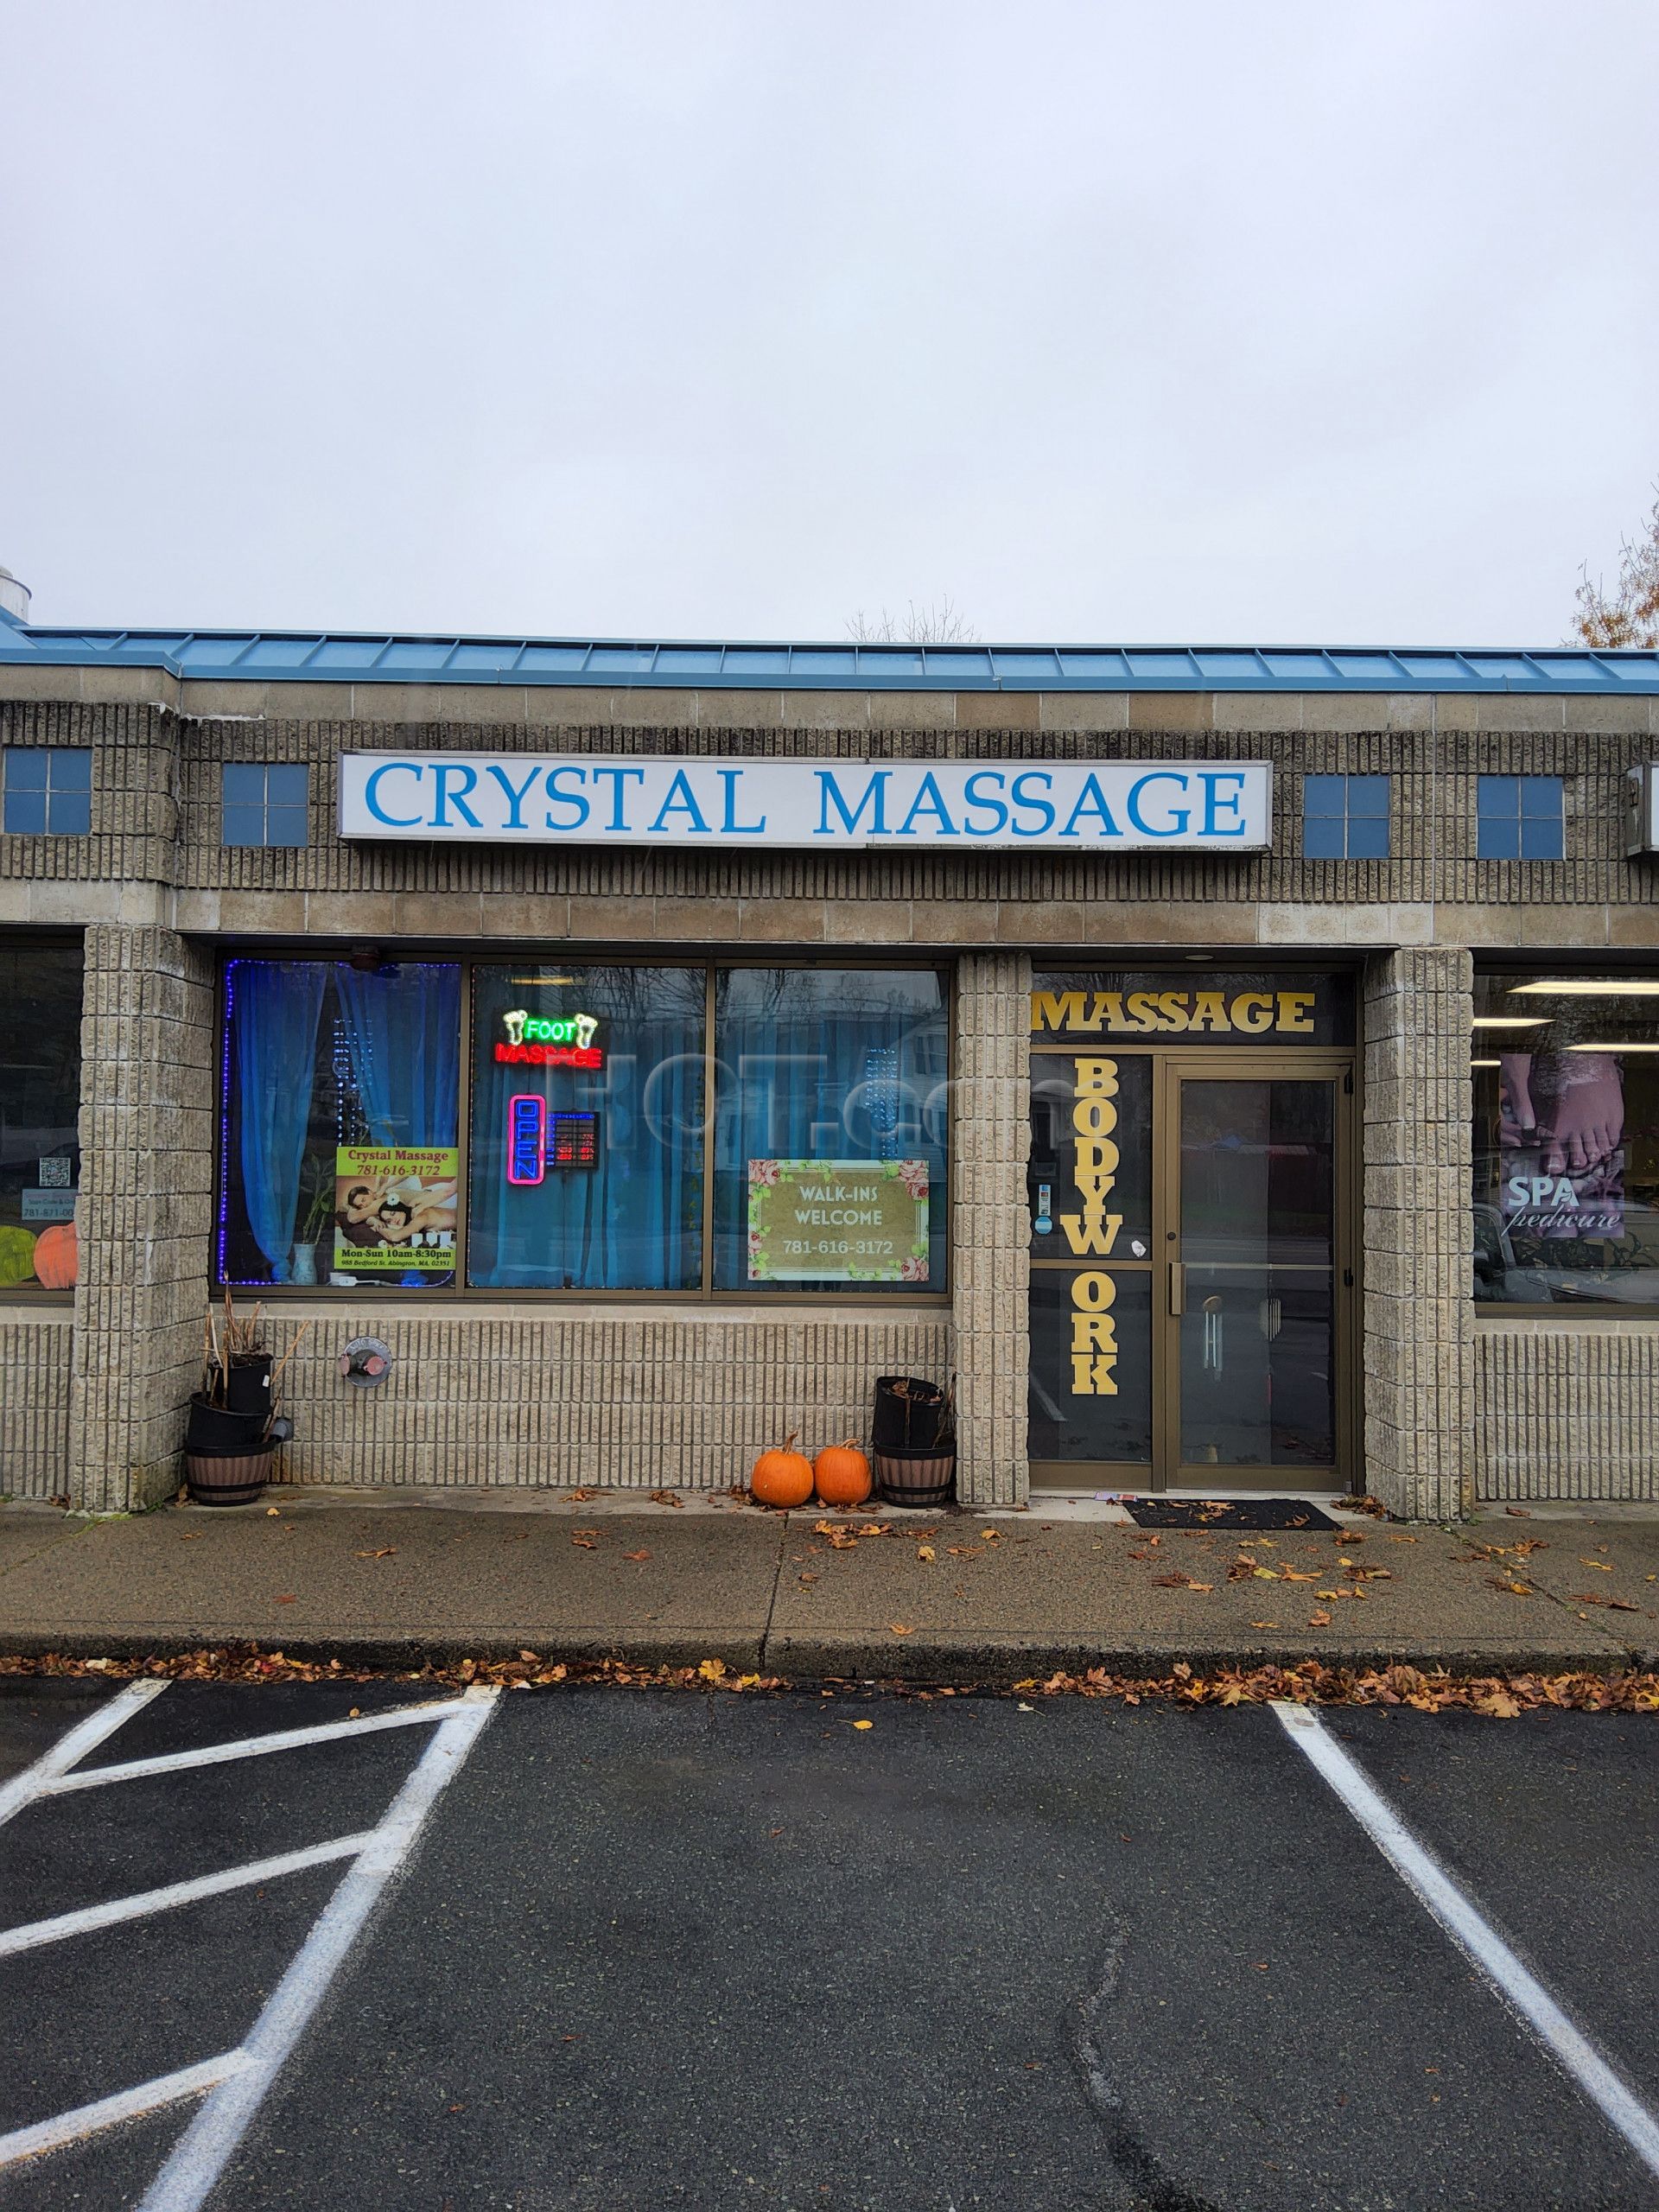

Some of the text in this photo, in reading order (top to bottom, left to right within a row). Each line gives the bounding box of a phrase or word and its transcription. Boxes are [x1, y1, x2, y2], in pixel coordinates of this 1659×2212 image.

[365, 762, 1246, 837] CRYSTAL MASSAGE
[1030, 991, 1316, 1033] MASSAGE
[524, 1019, 577, 1041] FOOT
[494, 1043, 602, 1069] MASSAGE
[514, 1100, 539, 1180] OPEN
[347, 1149, 448, 1164] Crystal Massage
[356, 1165, 441, 1176] 781-616-3172
[799, 1185, 879, 1202] WALK-INS
[1508, 1176, 1580, 1207] SPA
[794, 1209, 882, 1226] WELCOME
[1059, 1058, 1123, 1395] BODYWORK
[1500, 1204, 1621, 1237] pedicure
[340, 1249, 452, 1260] Mon-Sun 10am-8:30pm
[783, 1240, 893, 1255] 781-616-3172
